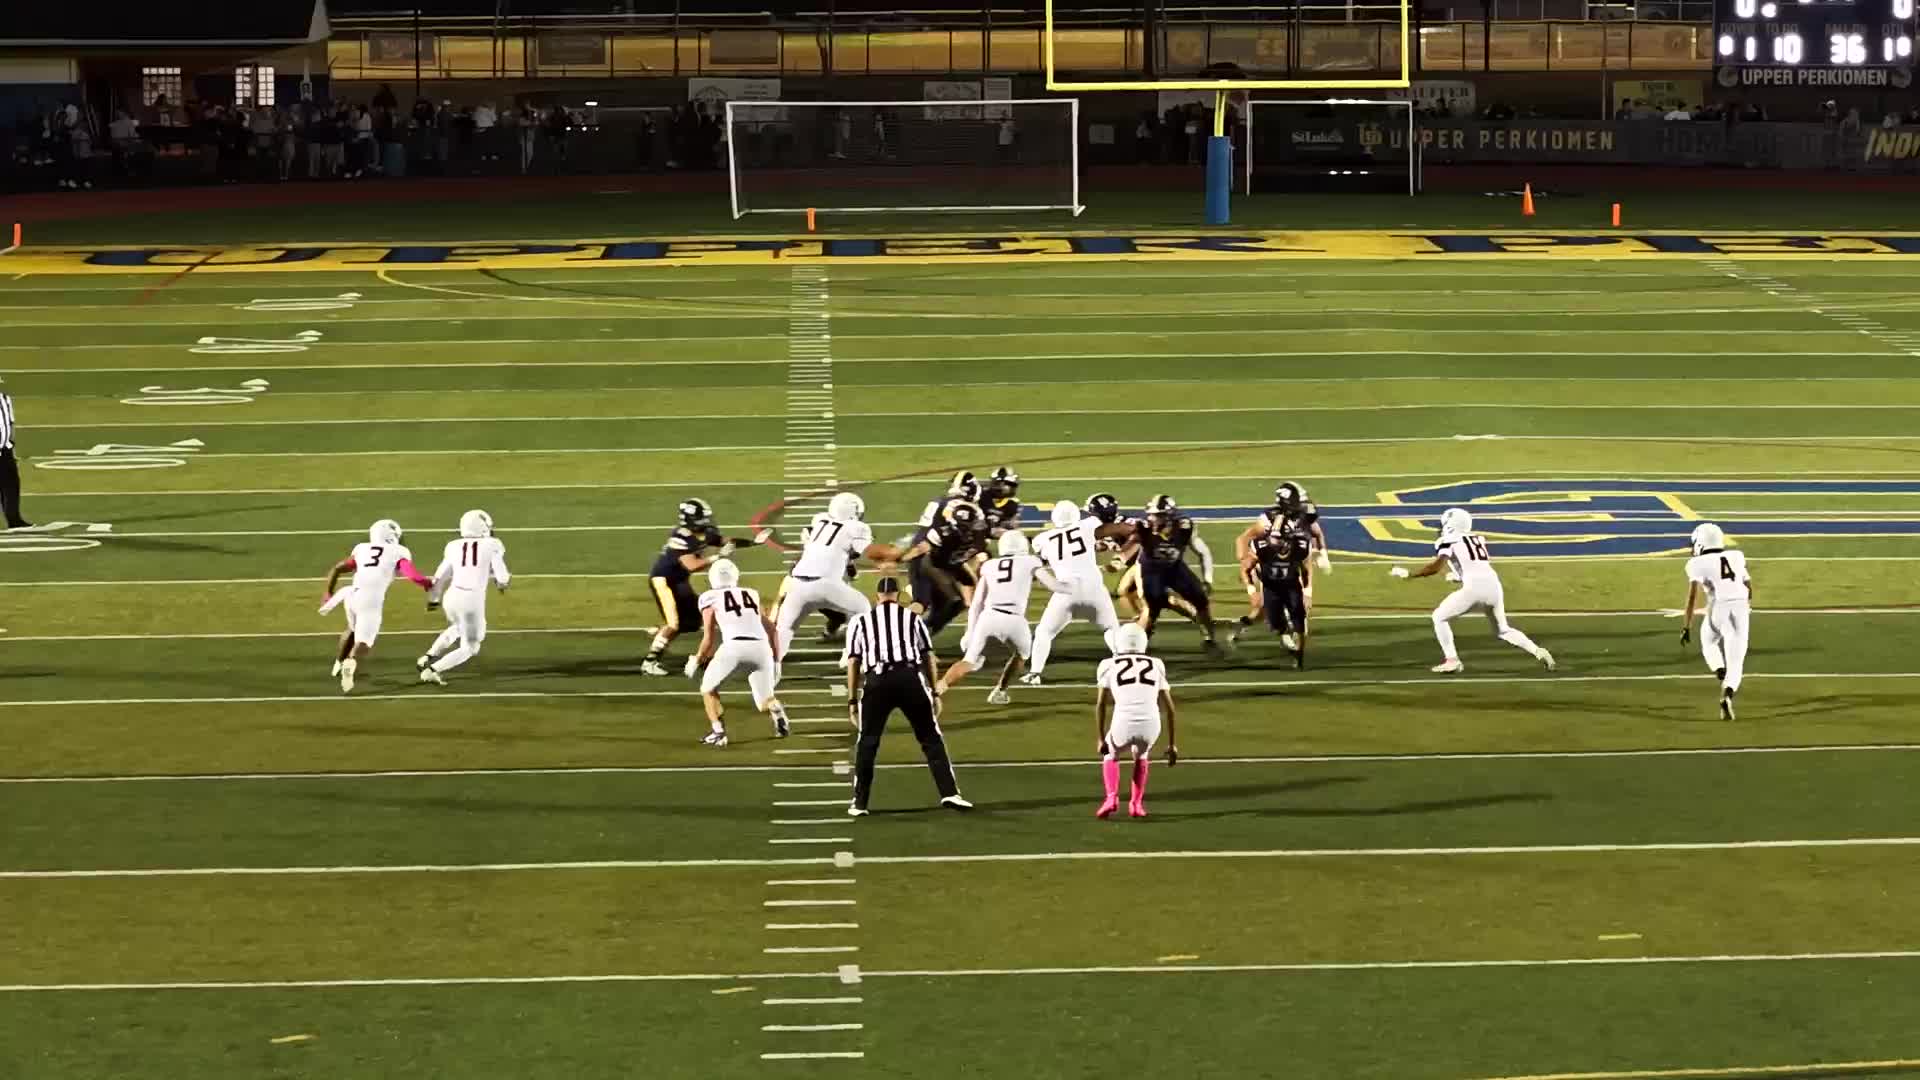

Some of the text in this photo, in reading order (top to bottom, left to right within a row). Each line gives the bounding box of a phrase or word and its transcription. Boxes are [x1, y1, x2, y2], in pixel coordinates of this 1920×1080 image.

[1774, 34, 1802, 63] 10
[1830, 34, 1866, 63] 36
[1742, 69, 1888, 85] UPPER PERKIOMEN
[1480, 129, 1614, 151] PERKIOMEN
[65, 235, 1326, 267] UPPER
[811, 519, 844, 546] 77
[1049, 527, 1087, 561] 75
[364, 546, 384, 568] 3
[461, 541, 478, 567] 11
[1462, 535, 1489, 561] 18
[996, 558, 1014, 583] 9
[1719, 555, 1736, 582] 4
[723, 590, 759, 617] 44
[1114, 657, 1156, 687] 22
